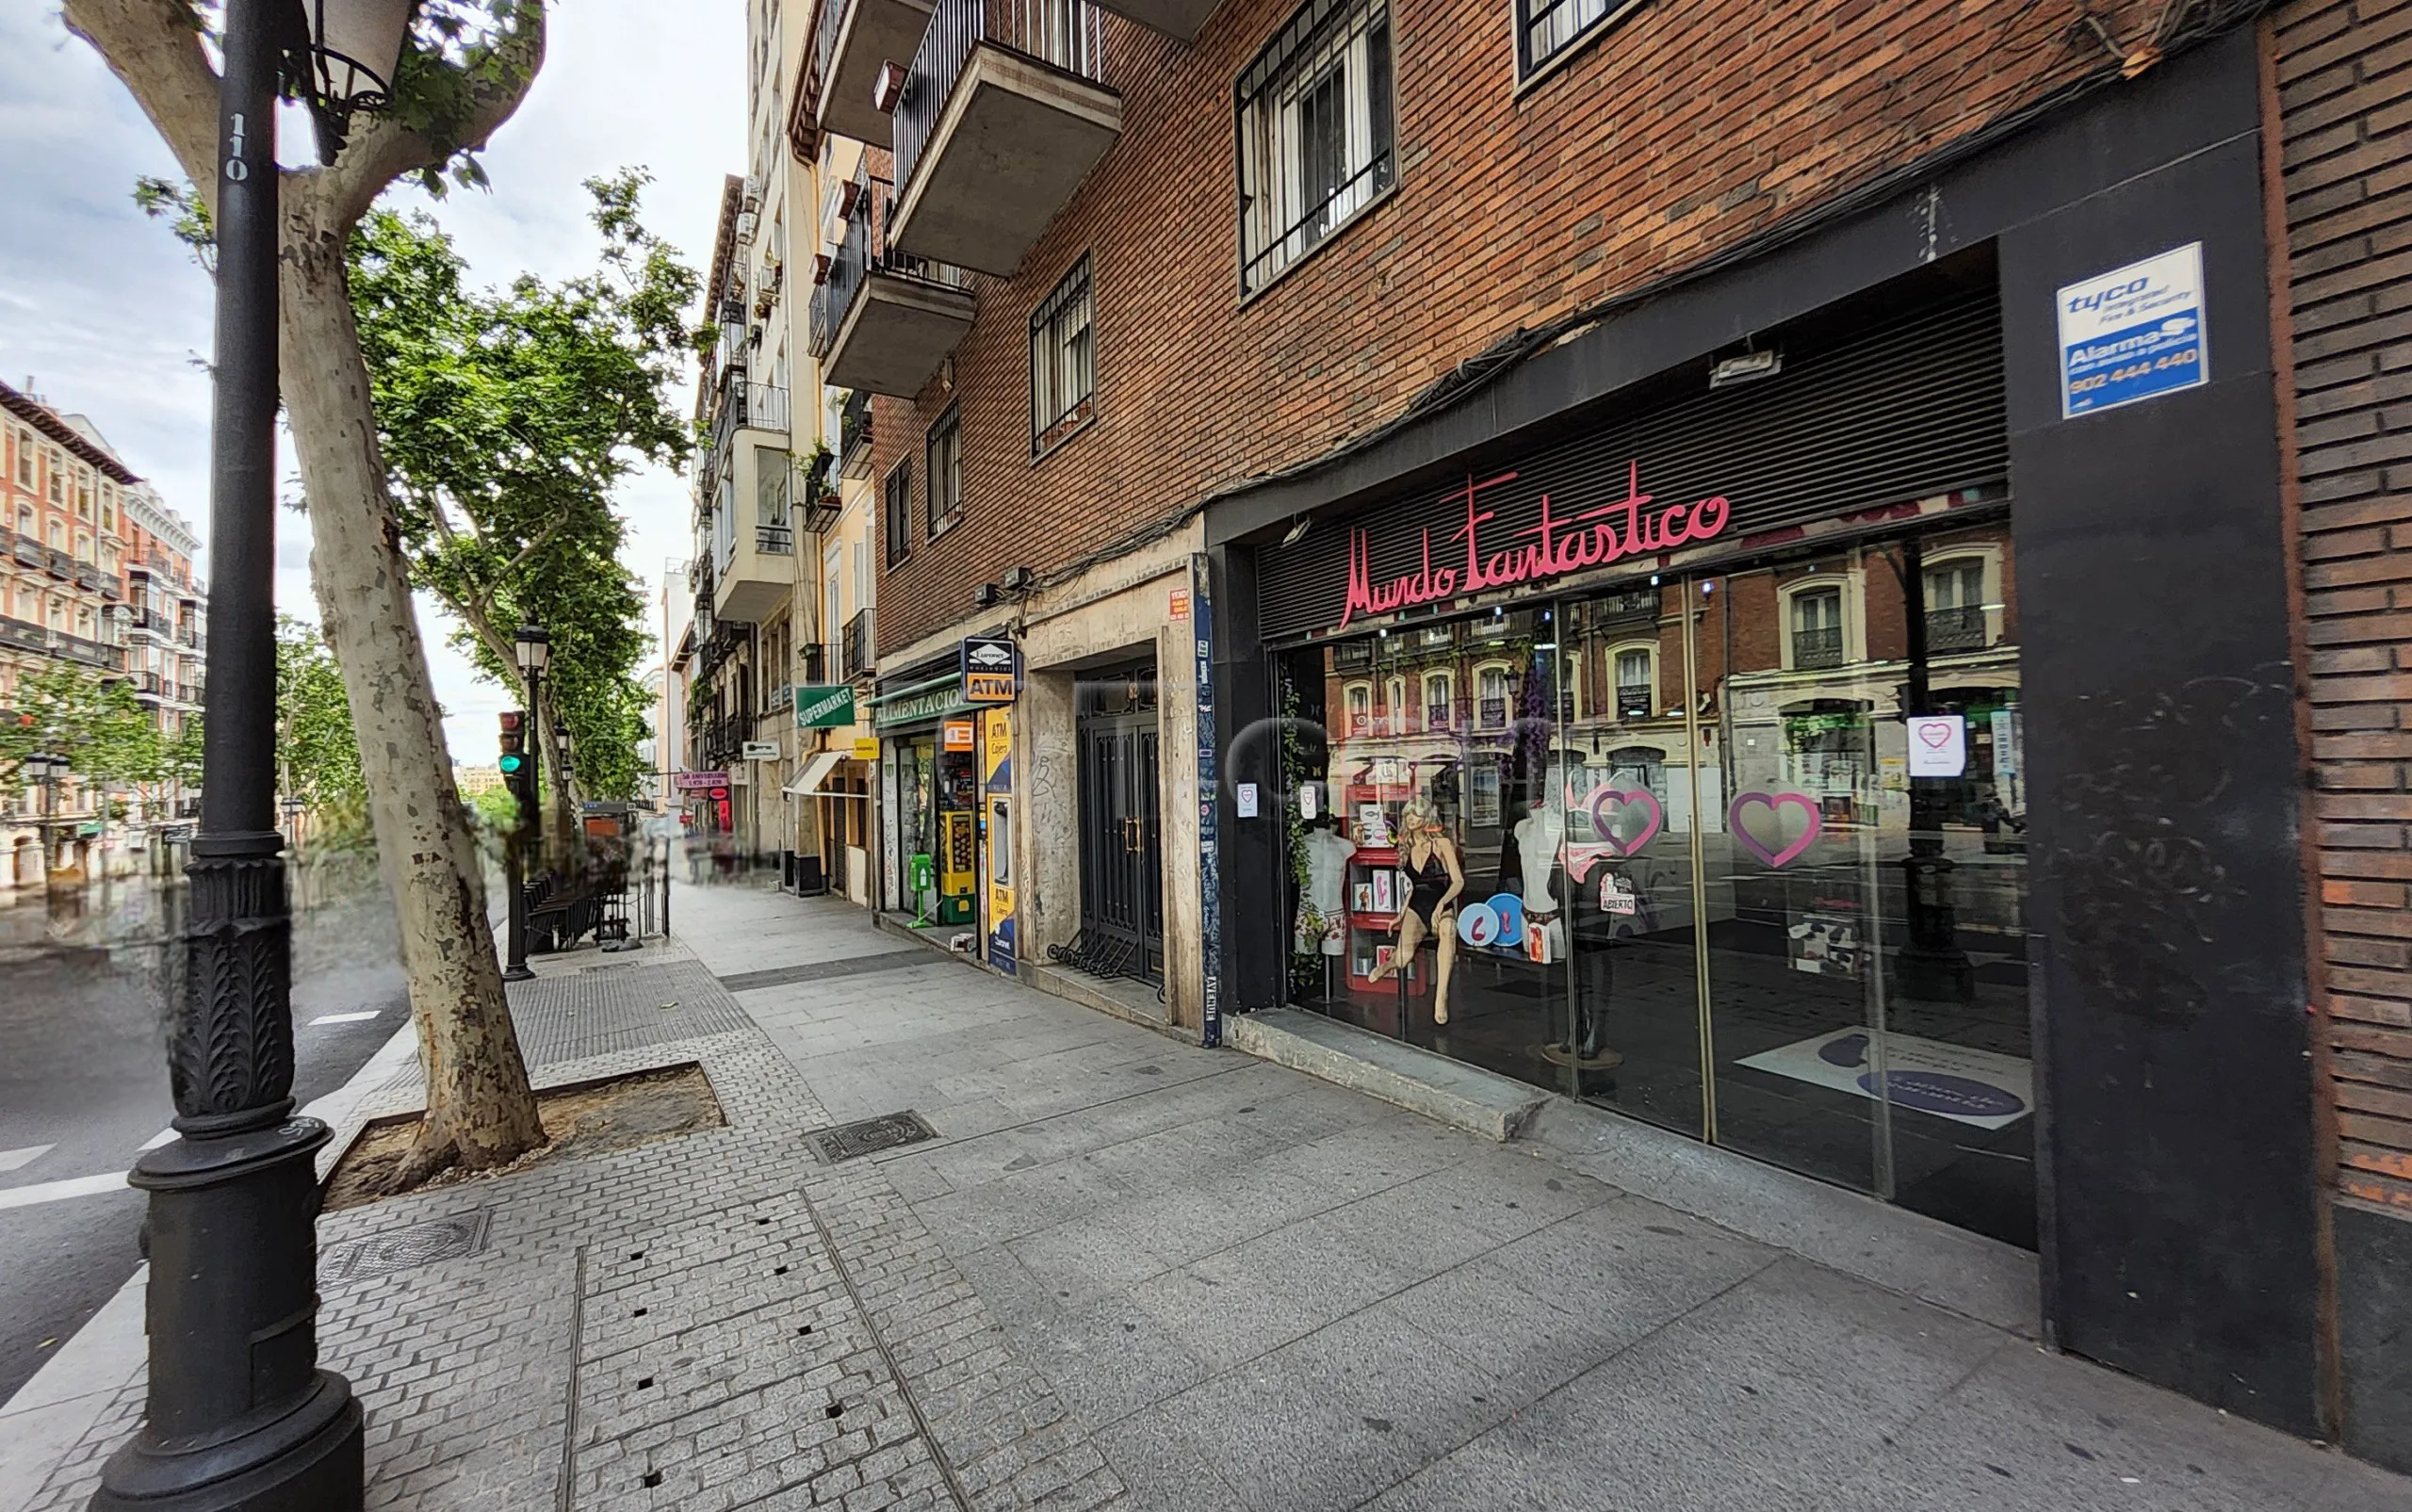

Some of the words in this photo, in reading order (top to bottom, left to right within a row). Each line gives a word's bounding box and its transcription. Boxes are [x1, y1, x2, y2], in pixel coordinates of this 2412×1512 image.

[2066, 277, 2149, 313] tyco
[2069, 373, 2109, 395] 902
[2109, 361, 2153, 382] 444
[2154, 349, 2197, 370] 440
[1339, 525, 1457, 630] Mundo
[1440, 459, 1730, 592] Fantastico
[970, 678, 1013, 695] ATM
[799, 688, 853, 726] SUPERMARKET
[991, 722, 1007, 739] ATM
[995, 888, 1009, 903] ATM
[1603, 900, 1633, 909] ABIERTO
